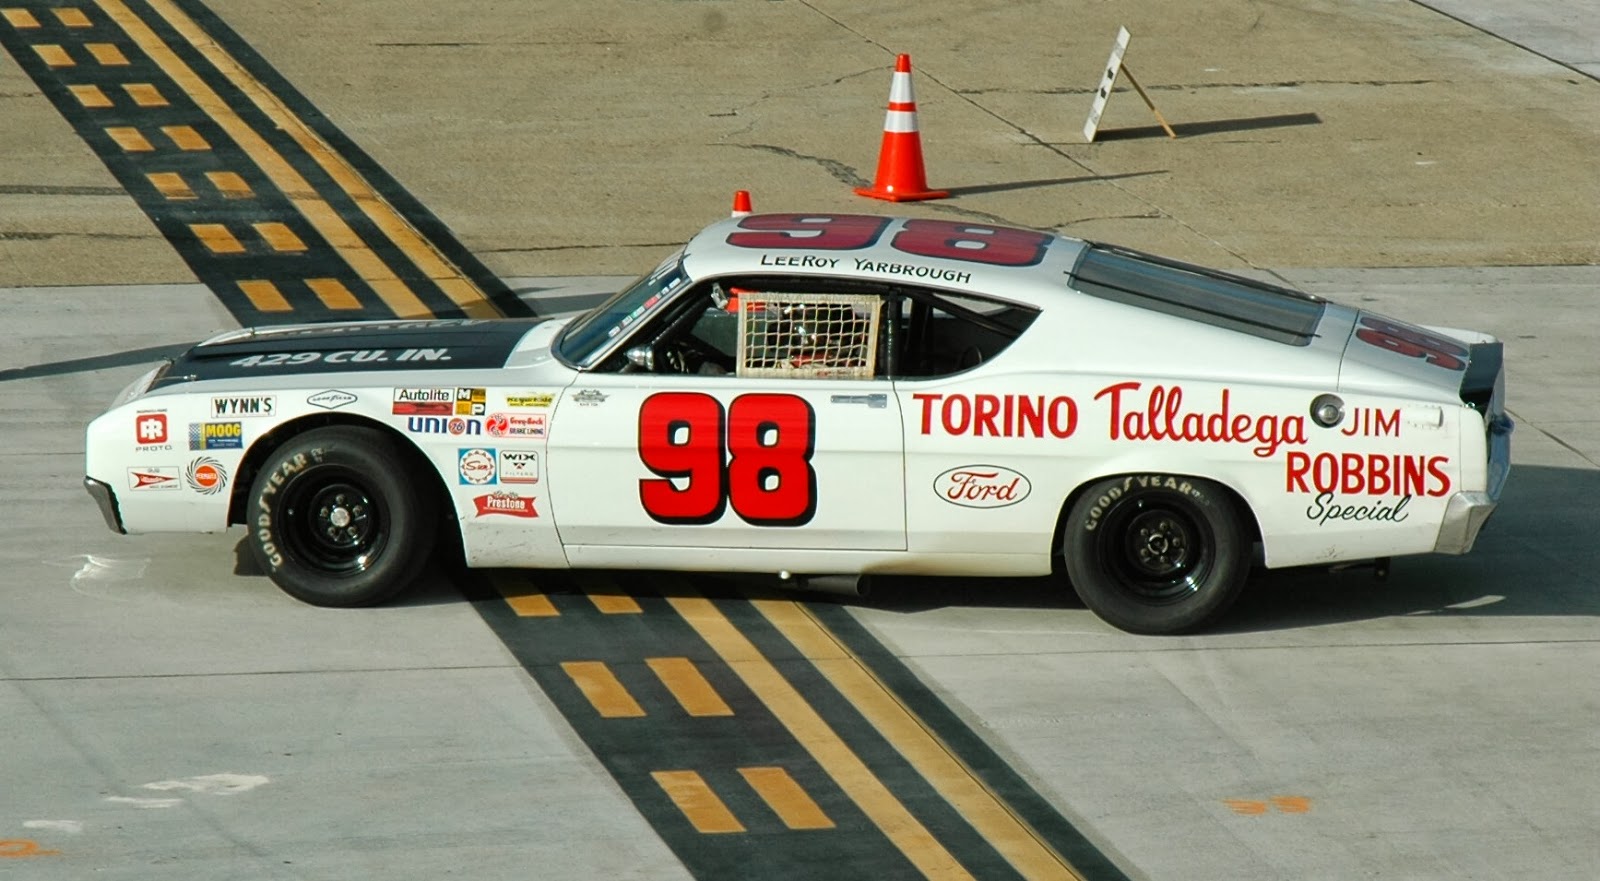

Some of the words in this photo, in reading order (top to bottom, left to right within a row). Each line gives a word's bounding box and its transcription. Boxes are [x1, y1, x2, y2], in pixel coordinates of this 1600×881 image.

[725, 213, 1056, 267] 98
[854, 257, 972, 285] YARBROUGH
[229, 351, 321, 367] 429
[324, 350, 387, 363] CU.
[396, 348, 452, 361] IN.
[214, 397, 272, 414] WYNN'S
[399, 388, 449, 401] Autolite
[912, 392, 1078, 439] TORINO
[1093, 381, 1309, 458] Talladega
[1341, 407, 1402, 437] JIM
[206, 423, 241, 438] MOOG
[135, 444, 173, 453] PROTO
[503, 453, 536, 461] WIX
[638, 391, 818, 527] 98
[947, 471, 1020, 501] Ford
[1286, 451, 1451, 497] ROBBINS
[487, 495, 526, 509] Prestone
[1306, 491, 1412, 526] Special
